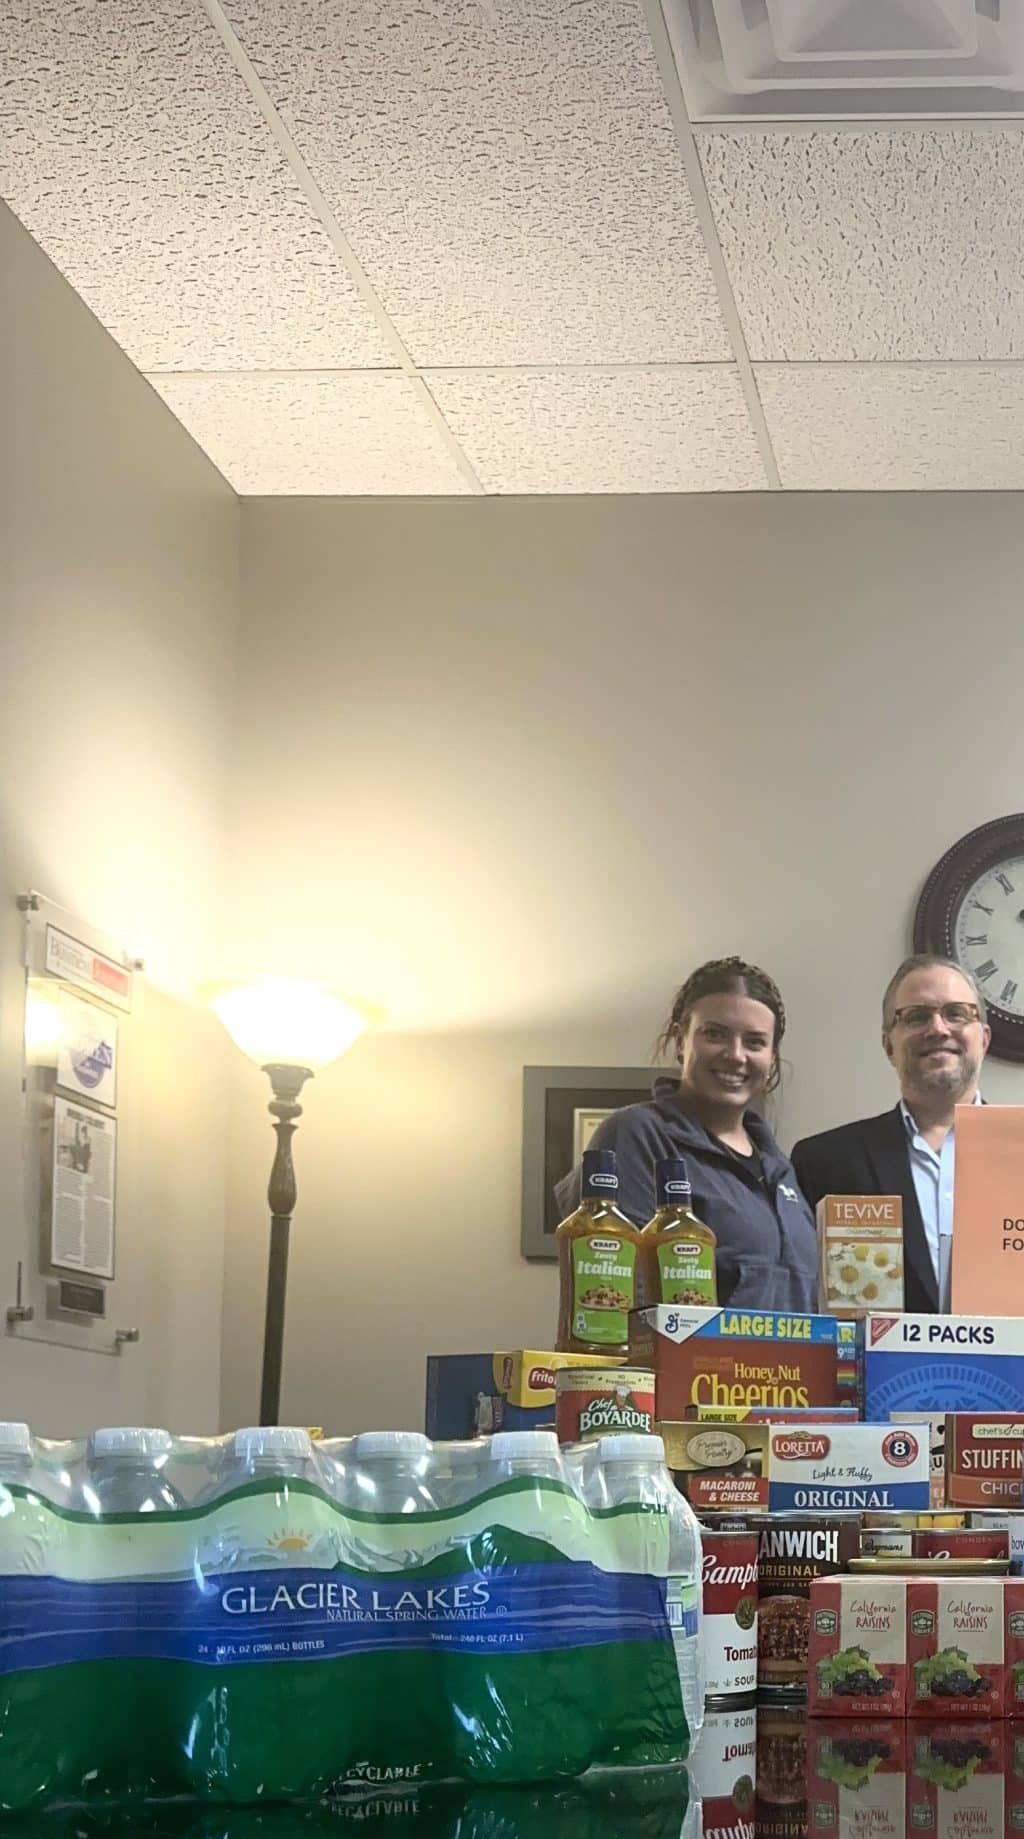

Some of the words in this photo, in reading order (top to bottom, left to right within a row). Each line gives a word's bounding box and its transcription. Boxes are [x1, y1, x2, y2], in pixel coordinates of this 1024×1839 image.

[577, 1261, 632, 1277] Italian
[663, 1266, 712, 1280] Italian
[719, 1313, 774, 1337] LARGE
[777, 1316, 812, 1339] SIZE
[903, 1324, 921, 1342] 12
[928, 1325, 995, 1345] PACKS
[531, 1370, 554, 1384] Frito
[734, 1363, 773, 1383] Honey
[778, 1365, 801, 1381] Nut
[691, 1374, 809, 1408] Cheerios
[579, 1410, 651, 1433] BOYARDEE
[775, 1440, 825, 1455] LORETTA
[893, 1441, 906, 1456] 8
[961, 1449, 1024, 1469] STUFFIN
[812, 1466, 837, 1480] Light
[846, 1466, 873, 1482] Fluffy
[700, 1480, 756, 1491] MACARONI
[981, 1481, 1023, 1496] CHIC
[708, 1491, 718, 1501] &
[719, 1491, 761, 1502] CHEESE
[793, 1490, 895, 1508] ORIGINAL
[760, 1530, 839, 1564] ANWICH
[701, 1553, 758, 1590] Camp
[759, 1565, 821, 1577] ORIGINAL
[222, 1583, 361, 1615] GLACIER
[372, 1581, 491, 1612] LAKES
[327, 1607, 380, 1622] NATURAL
[384, 1609, 439, 1622] SPRING
[441, 1606, 488, 1621] WATER
[849, 1599, 896, 1616] California
[947, 1599, 994, 1616] California
[855, 1616, 890, 1629] RAISINS
[953, 1616, 988, 1629] RAISINS
[292, 1640, 325, 1650] BOTTLES
[723, 1645, 756, 1662] Tomat
[734, 1676, 755, 1687] SOUP
[346, 1763, 422, 1780] CYCLABLE
